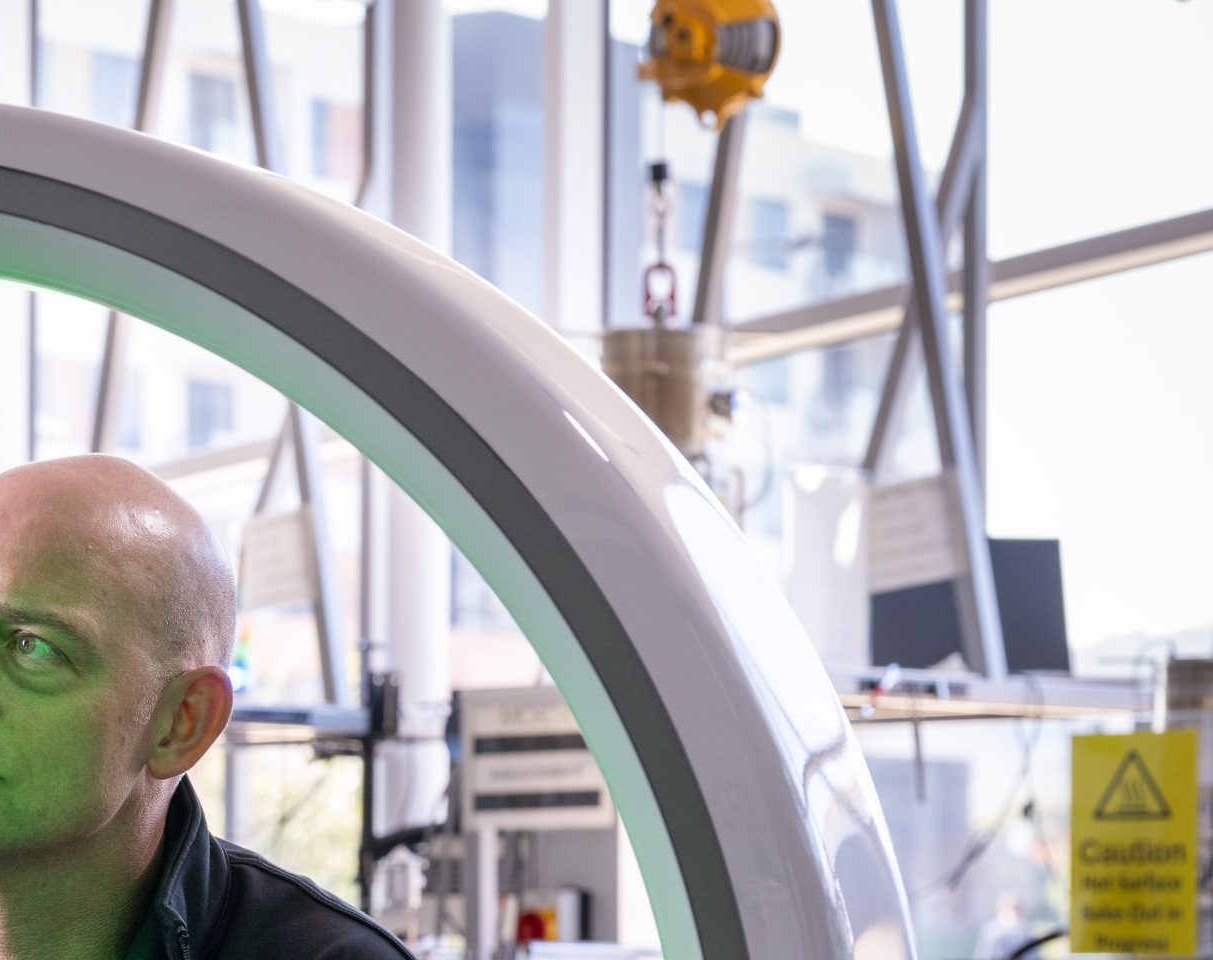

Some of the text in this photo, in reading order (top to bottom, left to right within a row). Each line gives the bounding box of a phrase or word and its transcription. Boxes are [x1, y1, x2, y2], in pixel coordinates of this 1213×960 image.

[1078, 838, 1186, 866] Caution
[1082, 873, 1183, 892] Hot Surface
